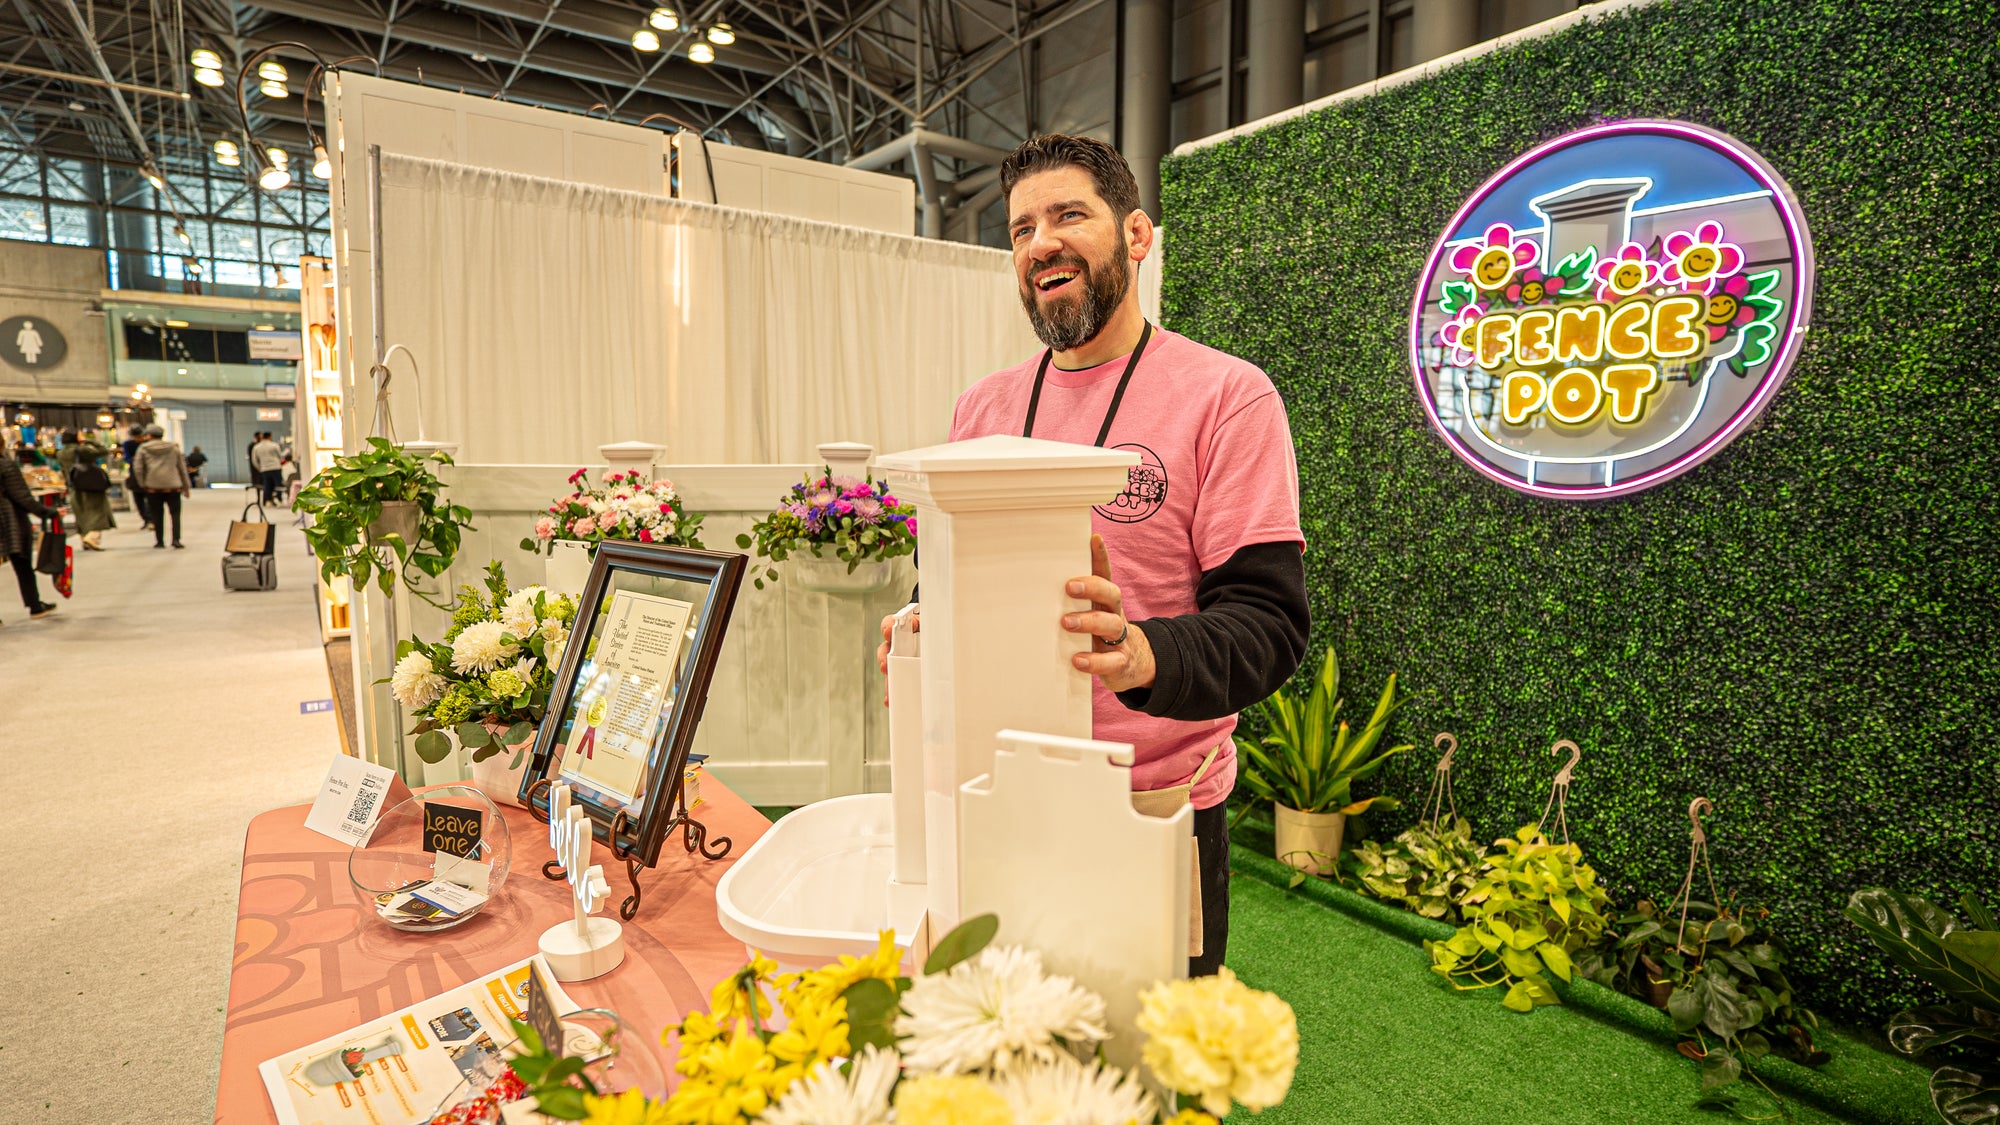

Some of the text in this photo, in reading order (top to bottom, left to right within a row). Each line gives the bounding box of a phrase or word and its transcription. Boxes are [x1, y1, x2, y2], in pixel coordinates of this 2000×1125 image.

[1475, 297, 1700, 369] FENCE
[1502, 364, 1658, 424] POT
[1123, 481, 1150, 497] NCE
[425, 808, 479, 836] Leave
[432, 833, 469, 854] one
[430, 1020, 449, 1038] BEFORE
